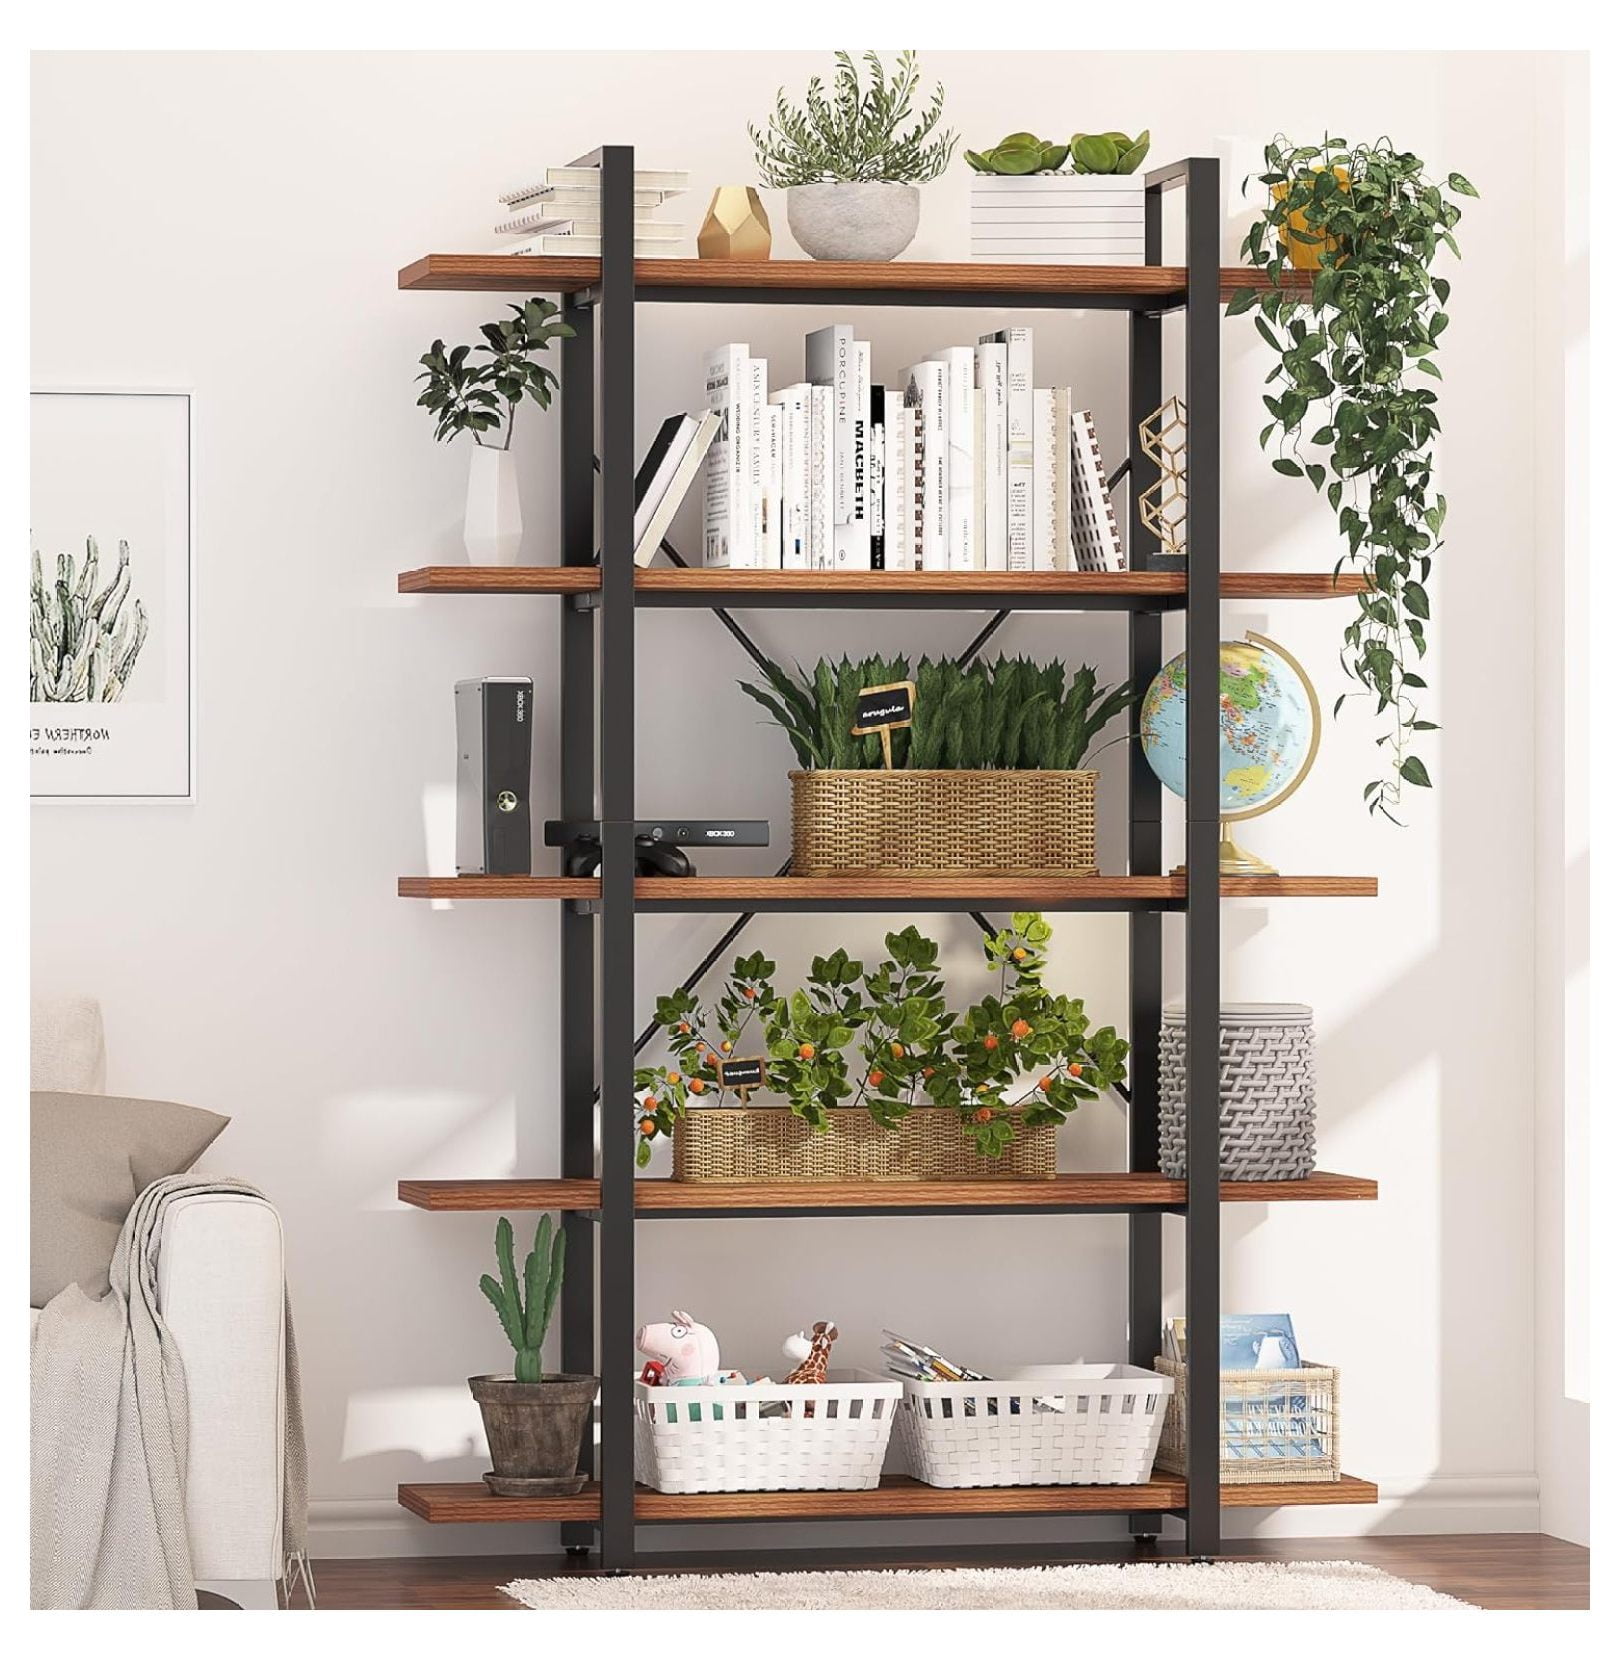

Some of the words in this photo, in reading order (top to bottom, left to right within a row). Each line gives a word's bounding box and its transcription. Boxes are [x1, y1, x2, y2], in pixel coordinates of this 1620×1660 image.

[838, 337, 847, 425] PORCUPINE
[753, 446, 761, 487] FAMILY
[854, 419, 865, 521] MACBETH
